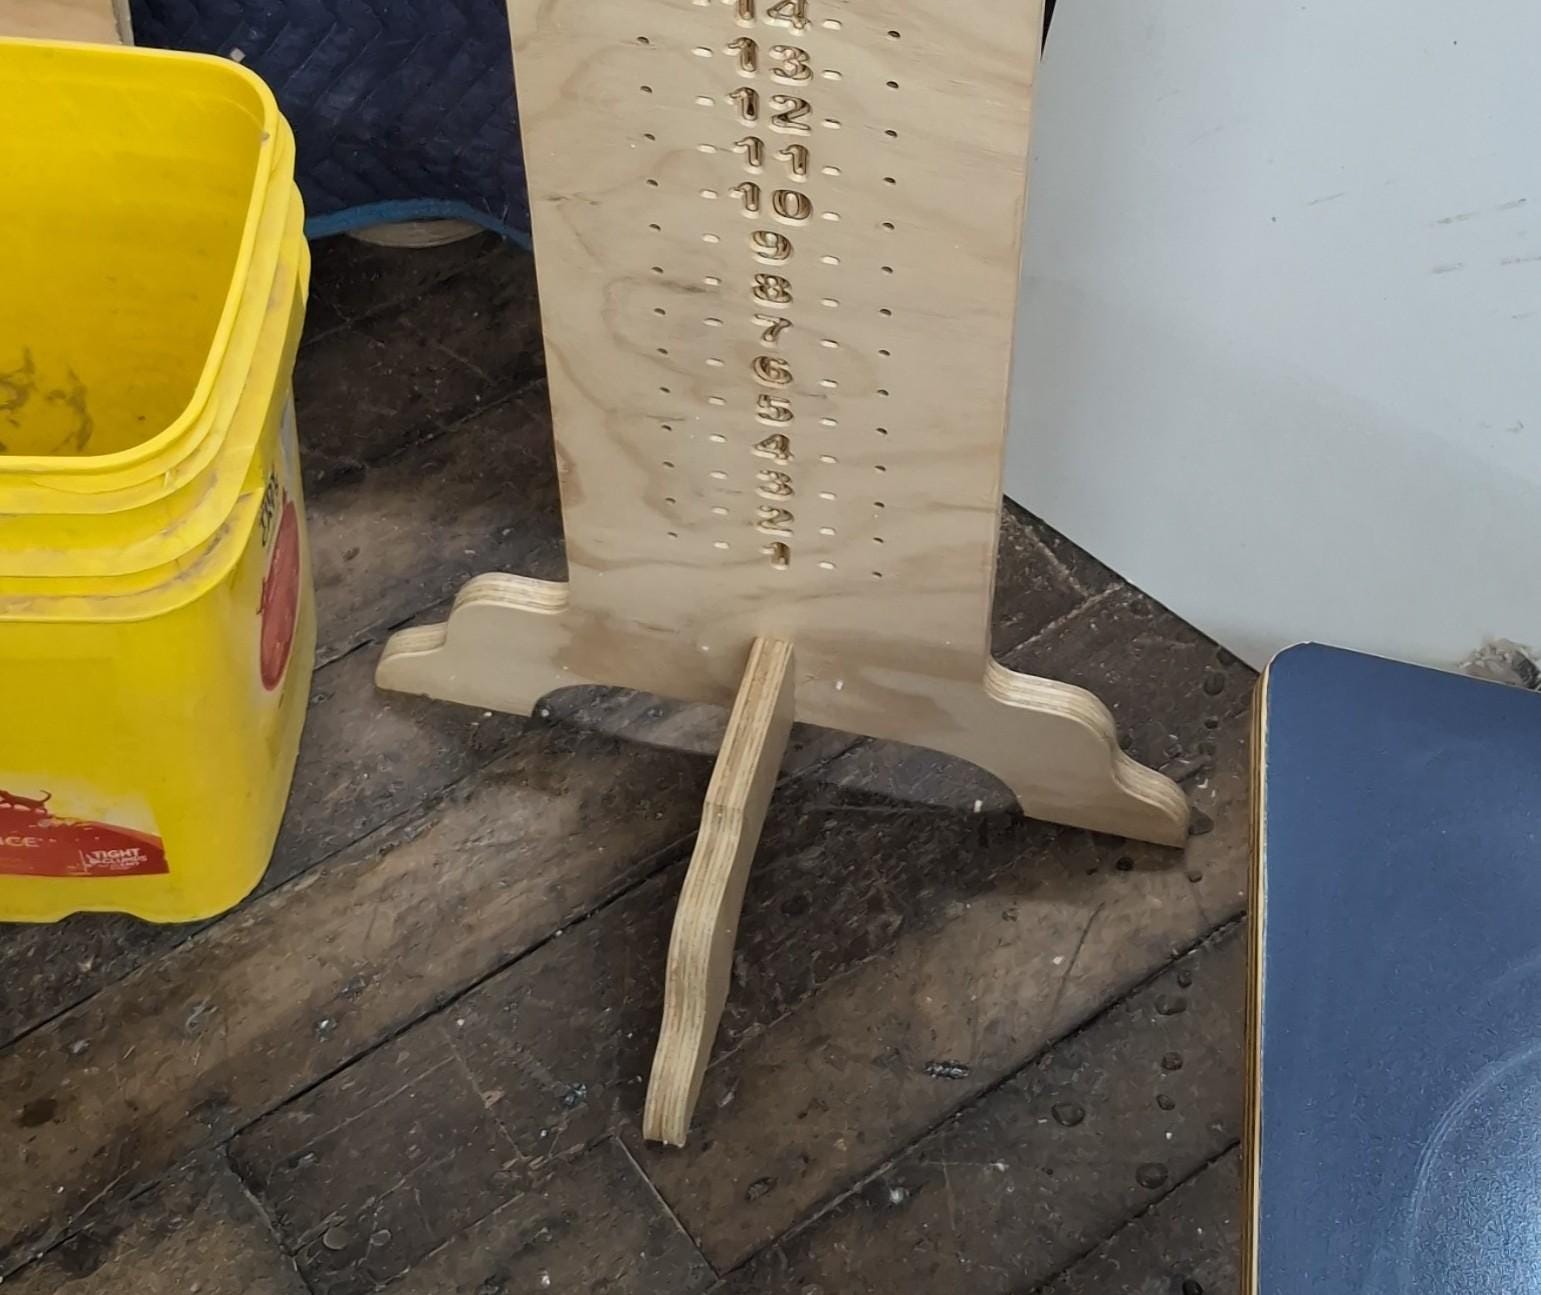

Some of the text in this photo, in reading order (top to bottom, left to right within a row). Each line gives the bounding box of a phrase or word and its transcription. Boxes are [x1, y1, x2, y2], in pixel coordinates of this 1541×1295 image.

[725, 37, 813, 83] 13
[728, 87, 812, 133] 12
[733, 136, 809, 179] 11
[729, 182, 813, 223] 10
[752, 230, 793, 263] 9
[752, 273, 793, 306] 8
[753, 313, 793, 346] 7
[752, 356, 793, 387] 6
[757, 394, 794, 425] 5
[753, 434, 794, 464] 4
[757, 470, 794, 499] 3
[757, 505, 794, 536] 2
[762, 542, 790, 569] 1
[92, 848, 140, 858] TIGHT
